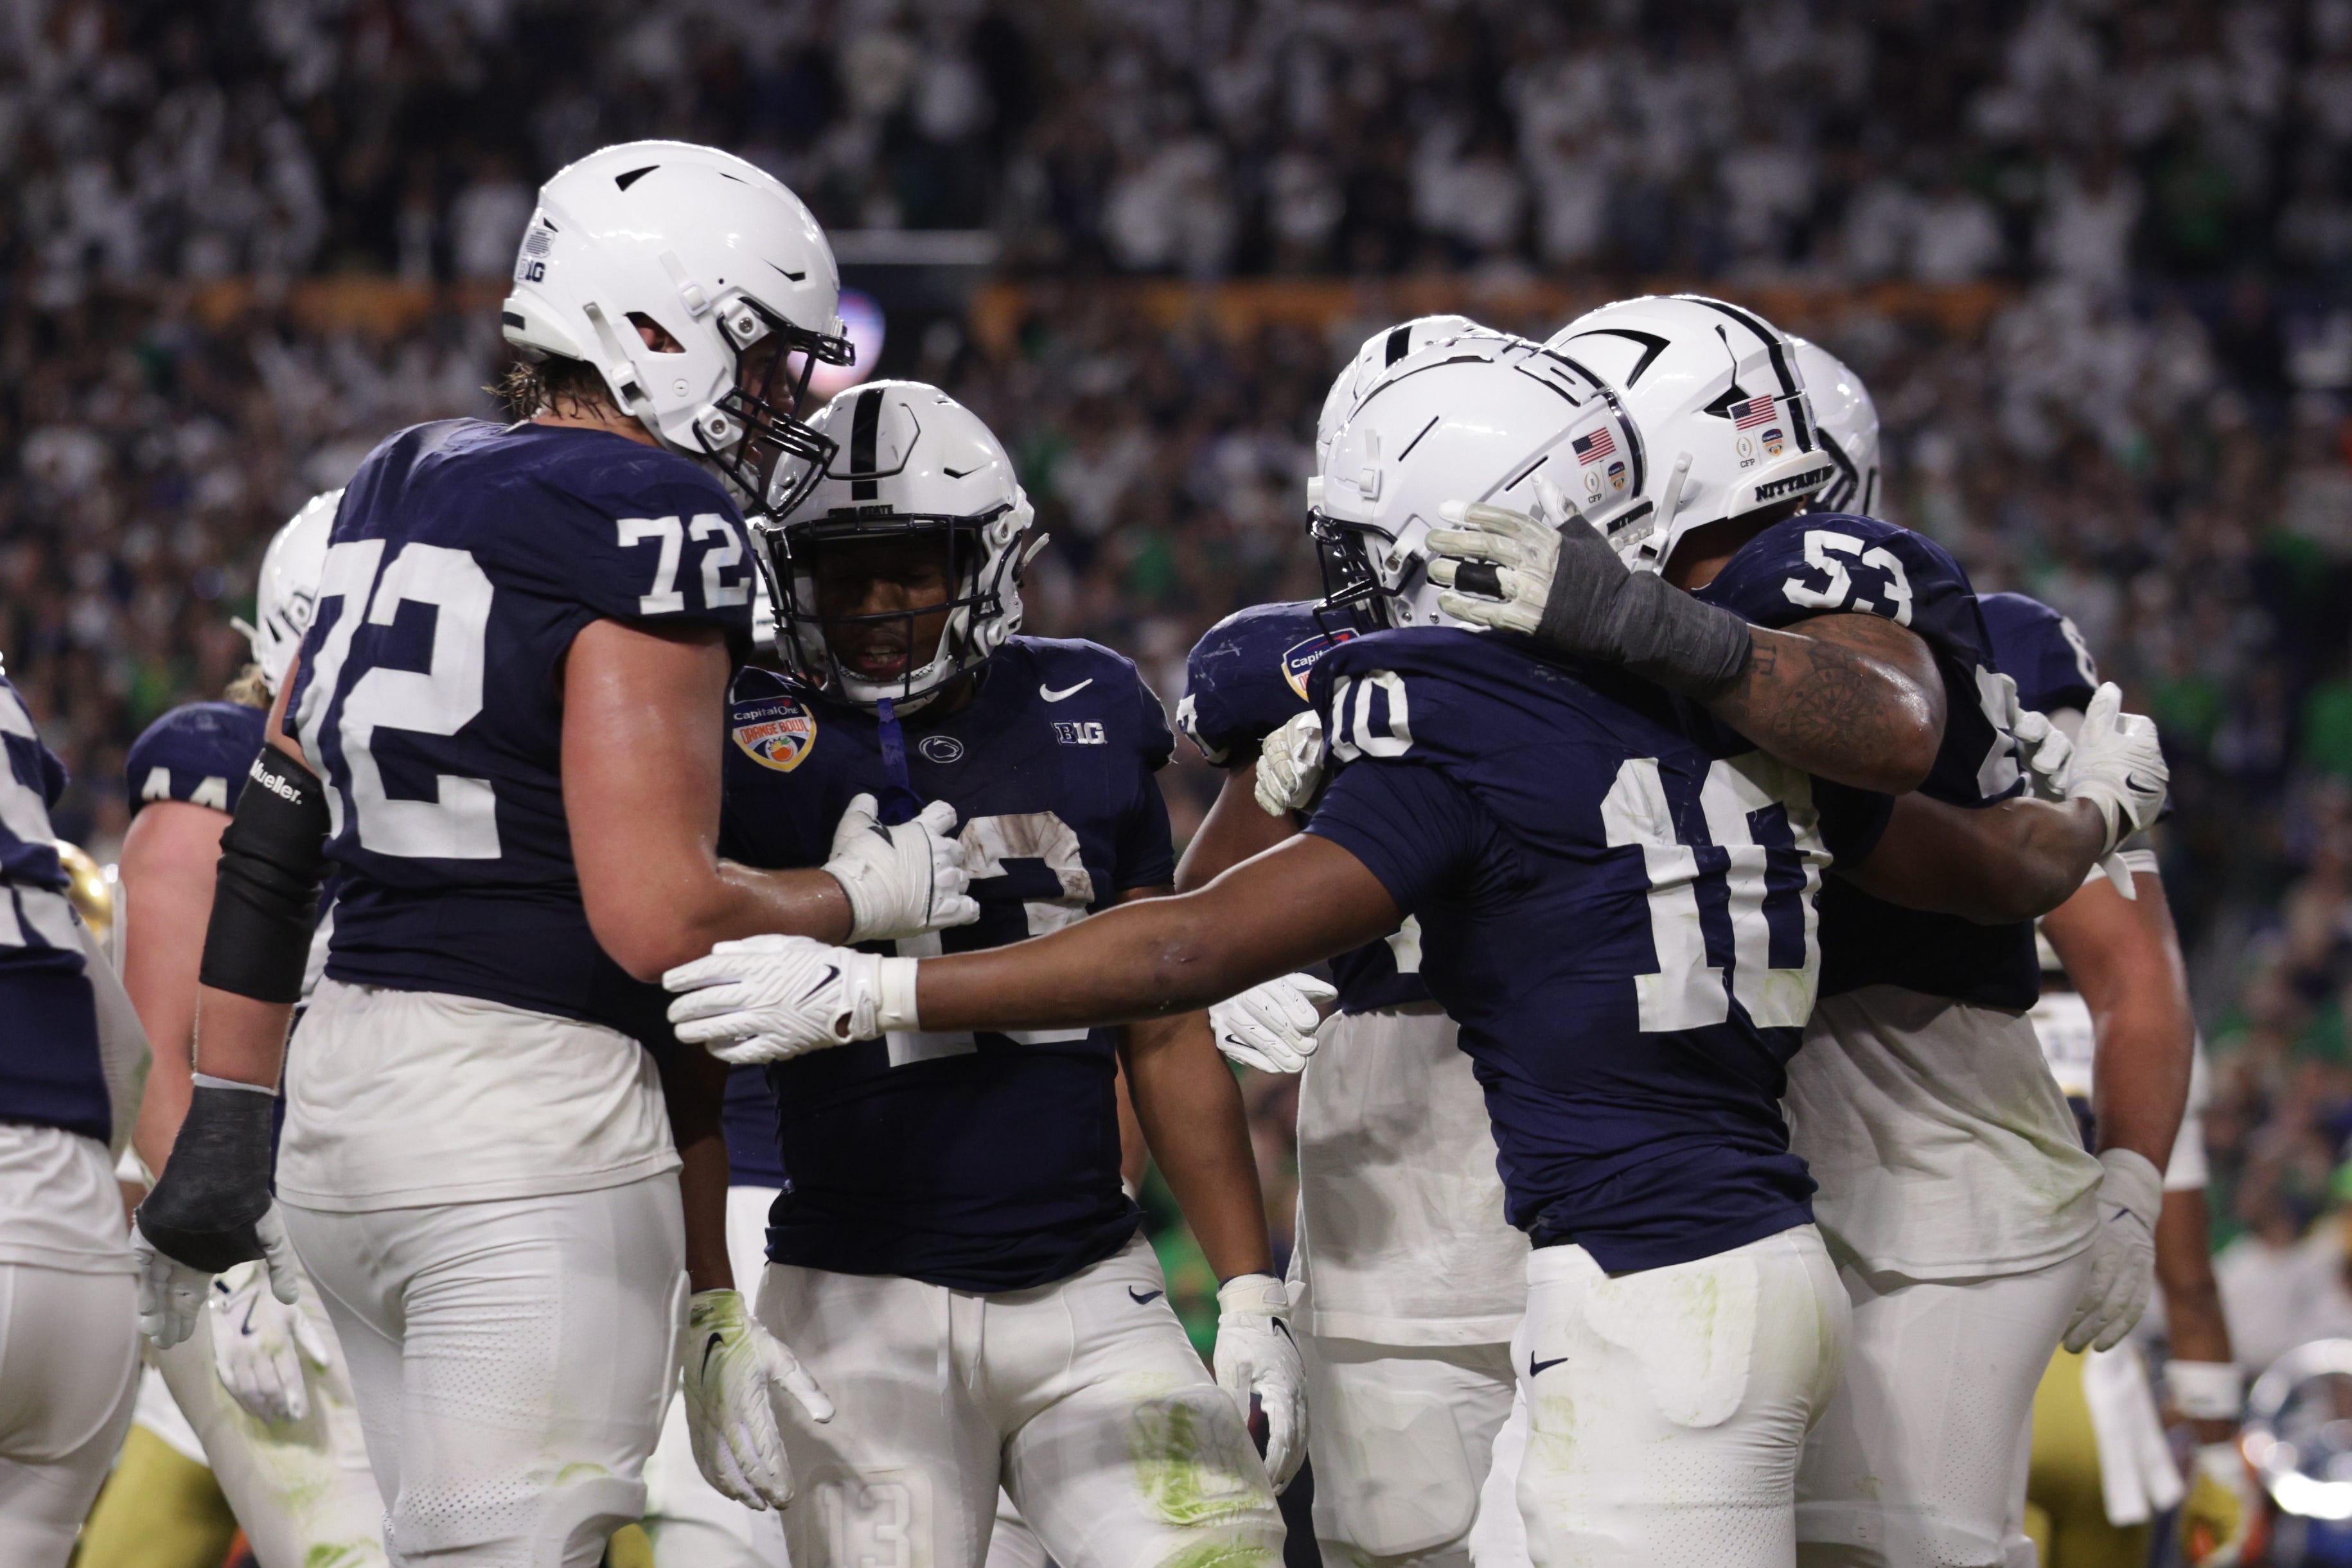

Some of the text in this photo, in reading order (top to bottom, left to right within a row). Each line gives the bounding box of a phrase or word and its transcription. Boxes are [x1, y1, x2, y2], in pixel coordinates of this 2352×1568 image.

[1588, 493, 1602, 503] CFP
[1740, 458, 1755, 468] CFP
[615, 513, 751, 615] 72
[1782, 530, 1913, 627] 53
[296, 538, 502, 859] 72
[740, 718, 810, 744] ORANGE BOWL
[1331, 669, 1415, 763] 10
[1600, 750, 1834, 1033] 10
